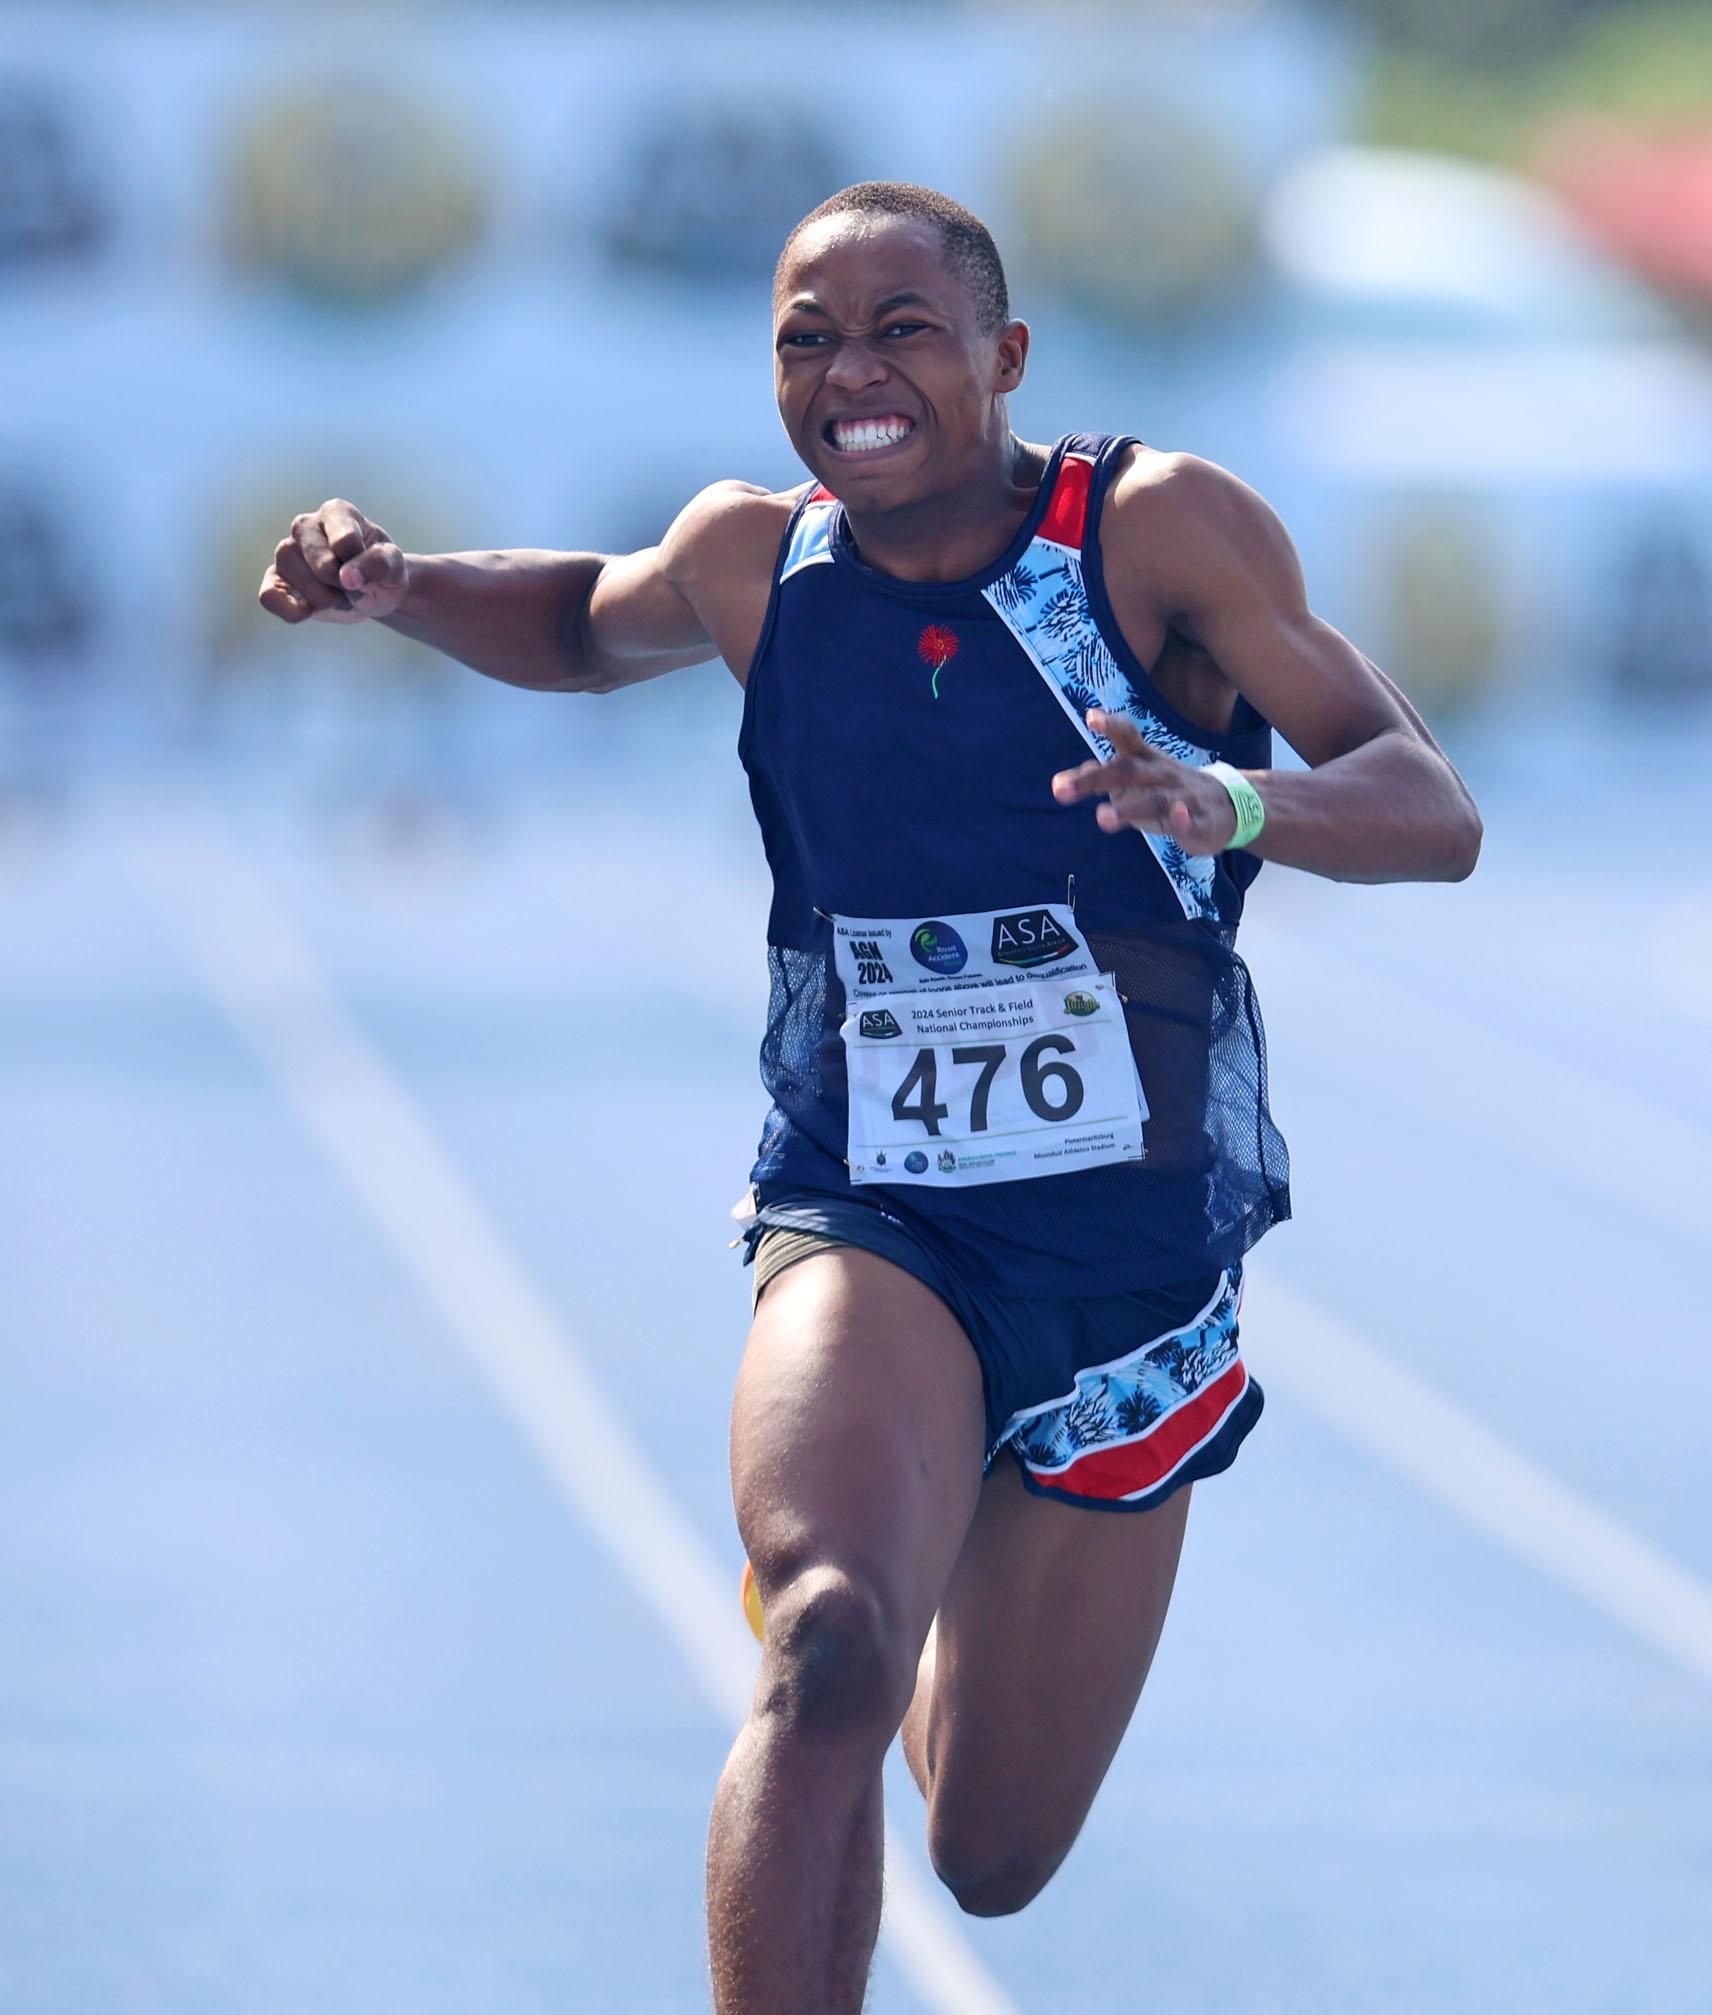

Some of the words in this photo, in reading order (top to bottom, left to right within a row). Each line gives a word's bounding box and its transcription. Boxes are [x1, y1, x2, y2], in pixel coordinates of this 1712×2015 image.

[837, 927, 849, 936] ASA
[885, 929, 892, 939] by
[998, 915, 1060, 949] ASA
[849, 941, 883, 960] AGN
[857, 961, 893, 984] 2024
[995, 977, 1014, 986] lead
[1015, 974, 1025, 982] to
[911, 1009, 934, 1019] 2024
[936, 1007, 967, 1018] Senior
[969, 1004, 996, 1015] Track
[998, 1003, 1006, 1012] &
[1009, 999, 1033, 1011] Field
[863, 1012, 895, 1027] ASA
[917, 1023, 957, 1033] National
[960, 1015, 1034, 1030] Championships
[891, 1034, 1084, 1136] 476
